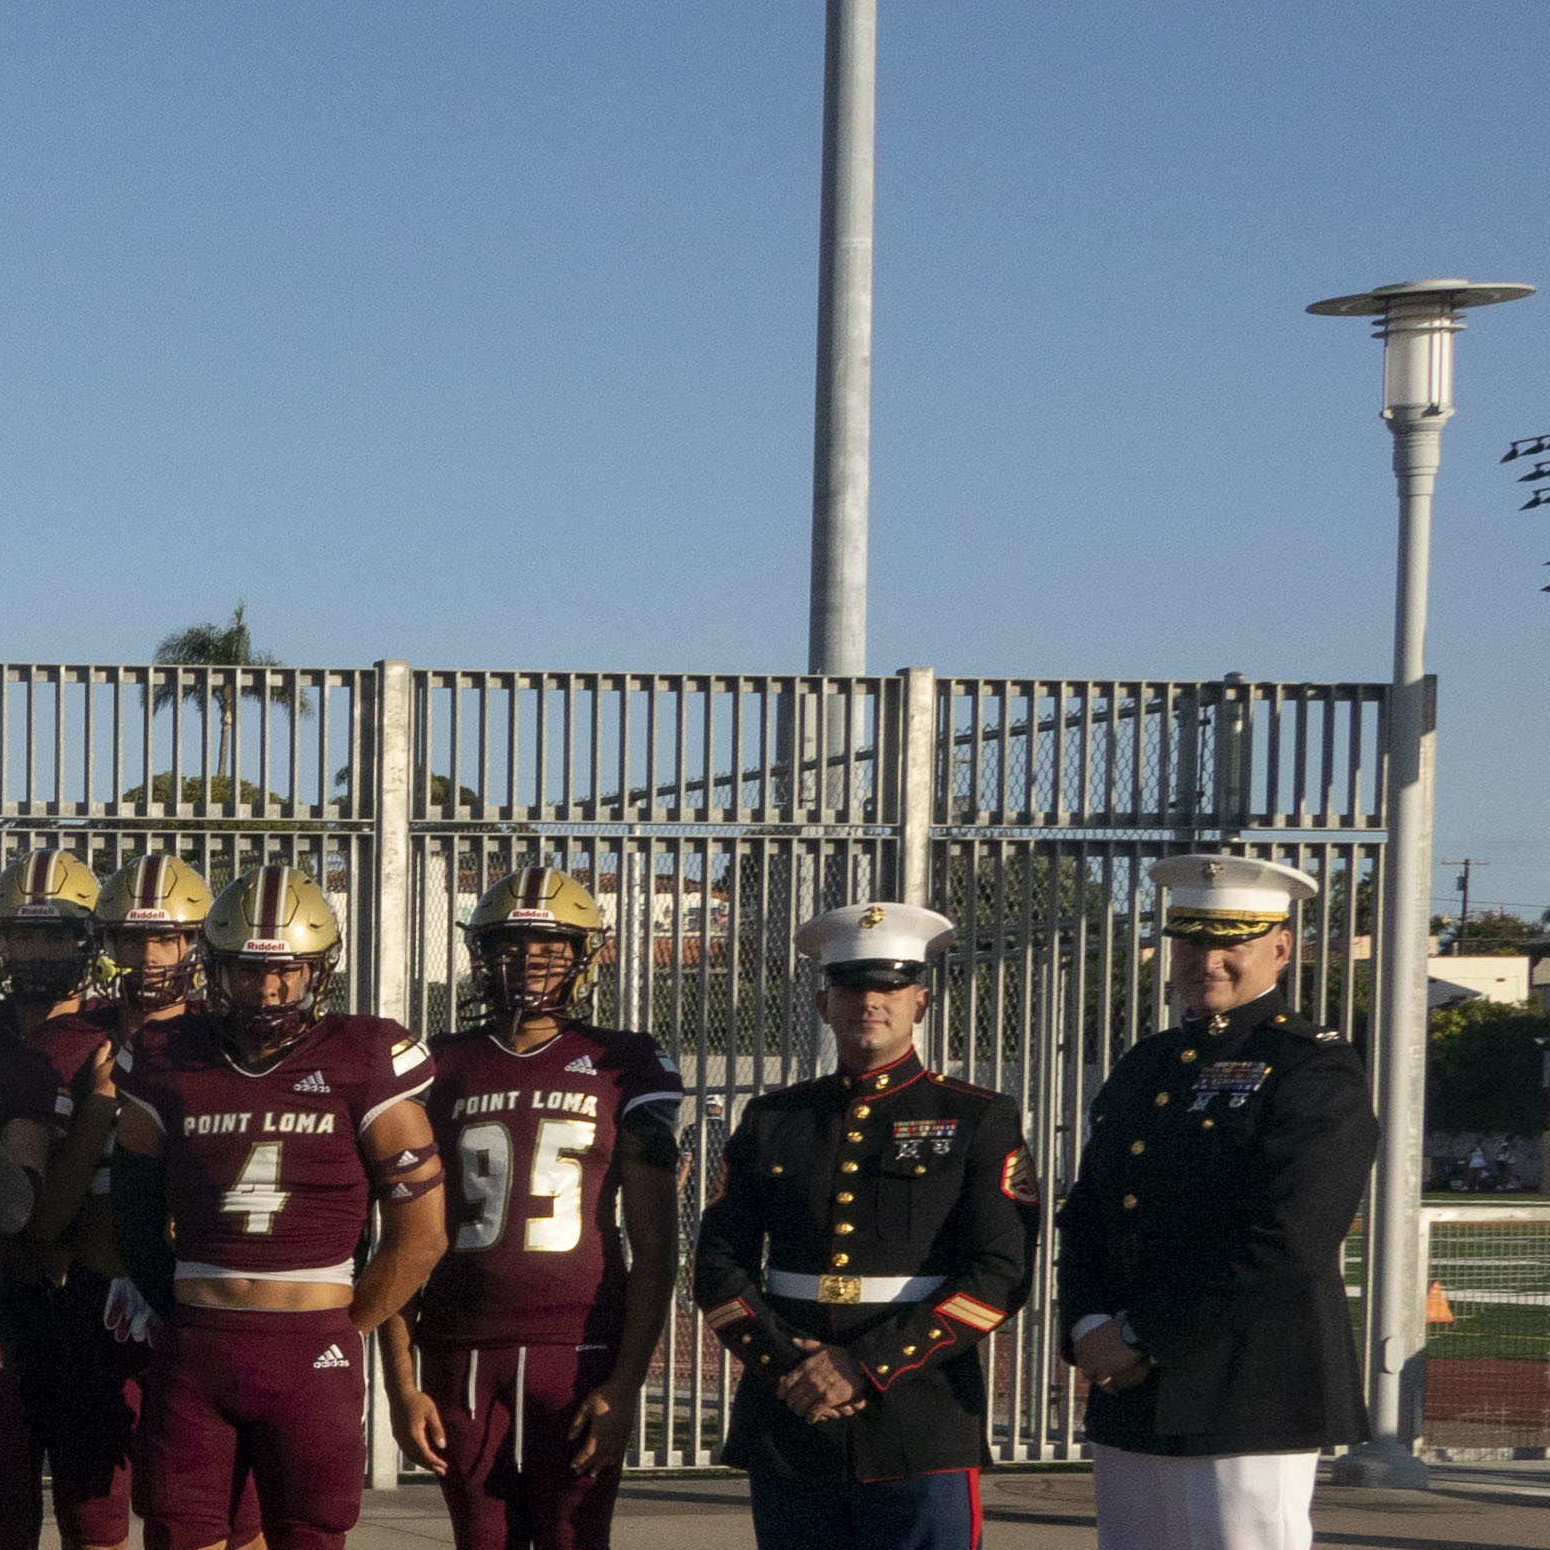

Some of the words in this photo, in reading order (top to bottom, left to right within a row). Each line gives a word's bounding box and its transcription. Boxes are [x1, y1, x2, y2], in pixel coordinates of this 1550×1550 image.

[130, 911, 164, 920] Riddell
[513, 911, 548, 919] Riddell
[247, 942, 285, 951] Riddell
[294, 1082, 331, 1093] adidas
[451, 1090, 521, 1121] POINT
[531, 1090, 598, 1118] LOMA
[183, 1112, 252, 1137] POINT
[262, 1113, 335, 1133] LOMA
[219, 1140, 292, 1237] 4
[452, 1117, 597, 1253] 95
[313, 1358, 350, 1369] adidas
